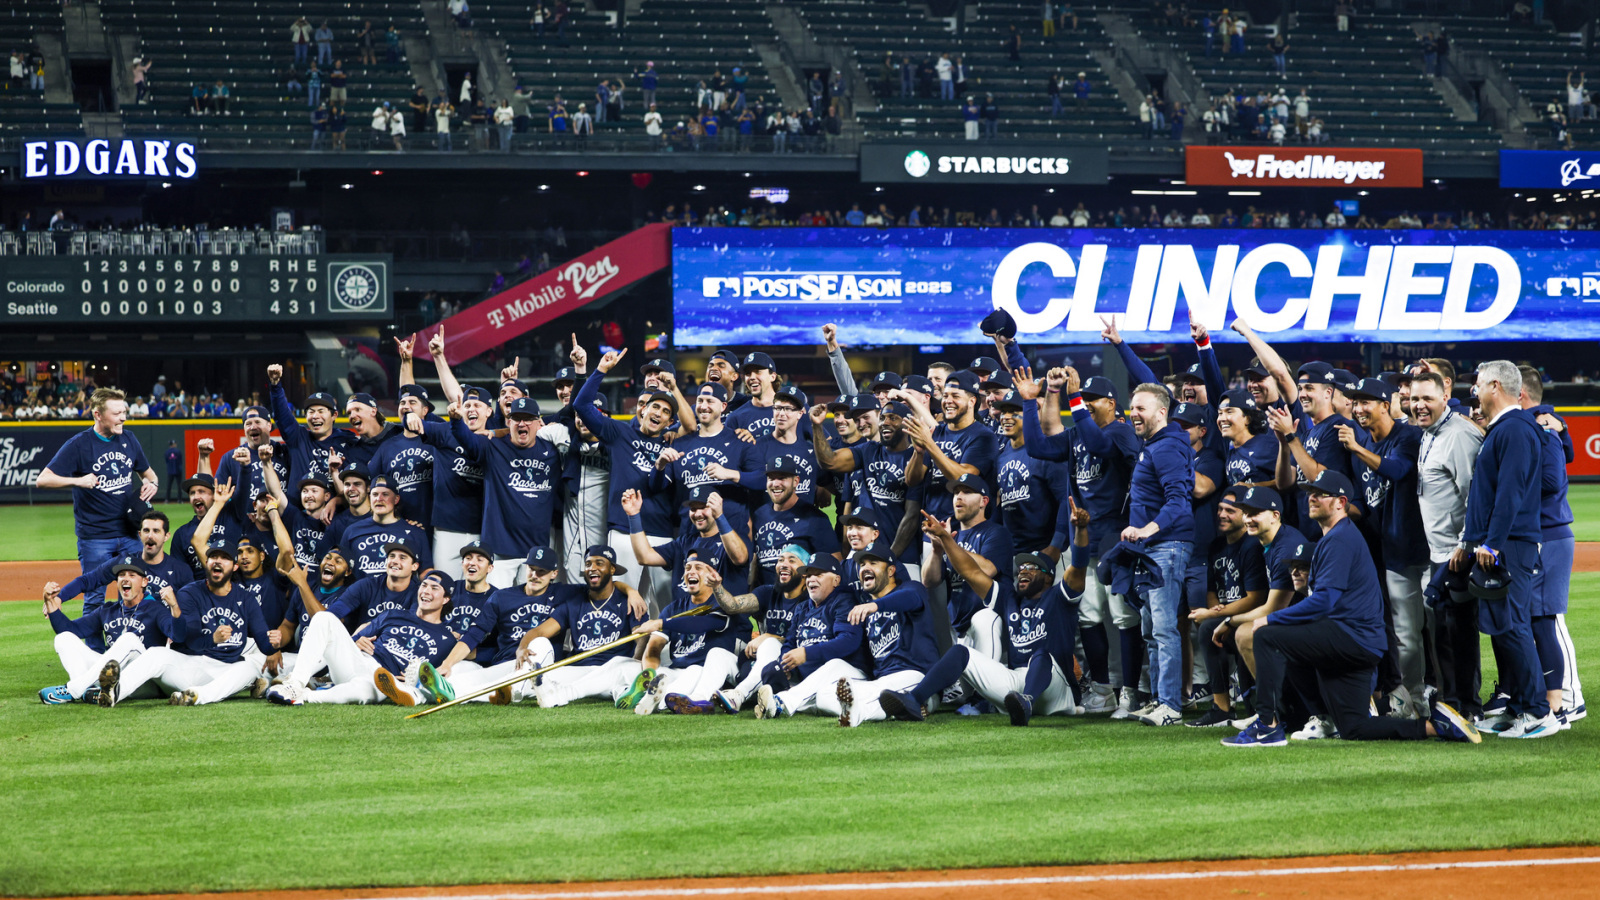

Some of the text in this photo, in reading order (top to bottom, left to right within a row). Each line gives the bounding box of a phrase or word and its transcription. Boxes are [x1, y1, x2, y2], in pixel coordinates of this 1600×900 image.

[25, 140, 196, 178] EDGAR'S
[937, 156, 1070, 175] STARBUCKS
[83, 259, 317, 273] 1 2 3 4 5 6 7 8 9 R H E
[7, 277, 317, 294] Colorado 0 1 0 0 0 2 0 0 0 3 7 0
[905, 281, 953, 295] 2025
[991, 242, 1521, 337] CLINCHED
[7, 299, 316, 316] Seattle 0 0 0 0 1 0 0 3 4 3 1
[504, 283, 567, 323] Mobile
[92, 451, 134, 472] OCTOBER
[390, 447, 434, 468] OCTOBER
[681, 446, 729, 467] OCTOBER
[201, 607, 245, 629] OCTOBER
[576, 610, 622, 630] OCTOBER
[390, 626, 437, 656] OCTOBER
